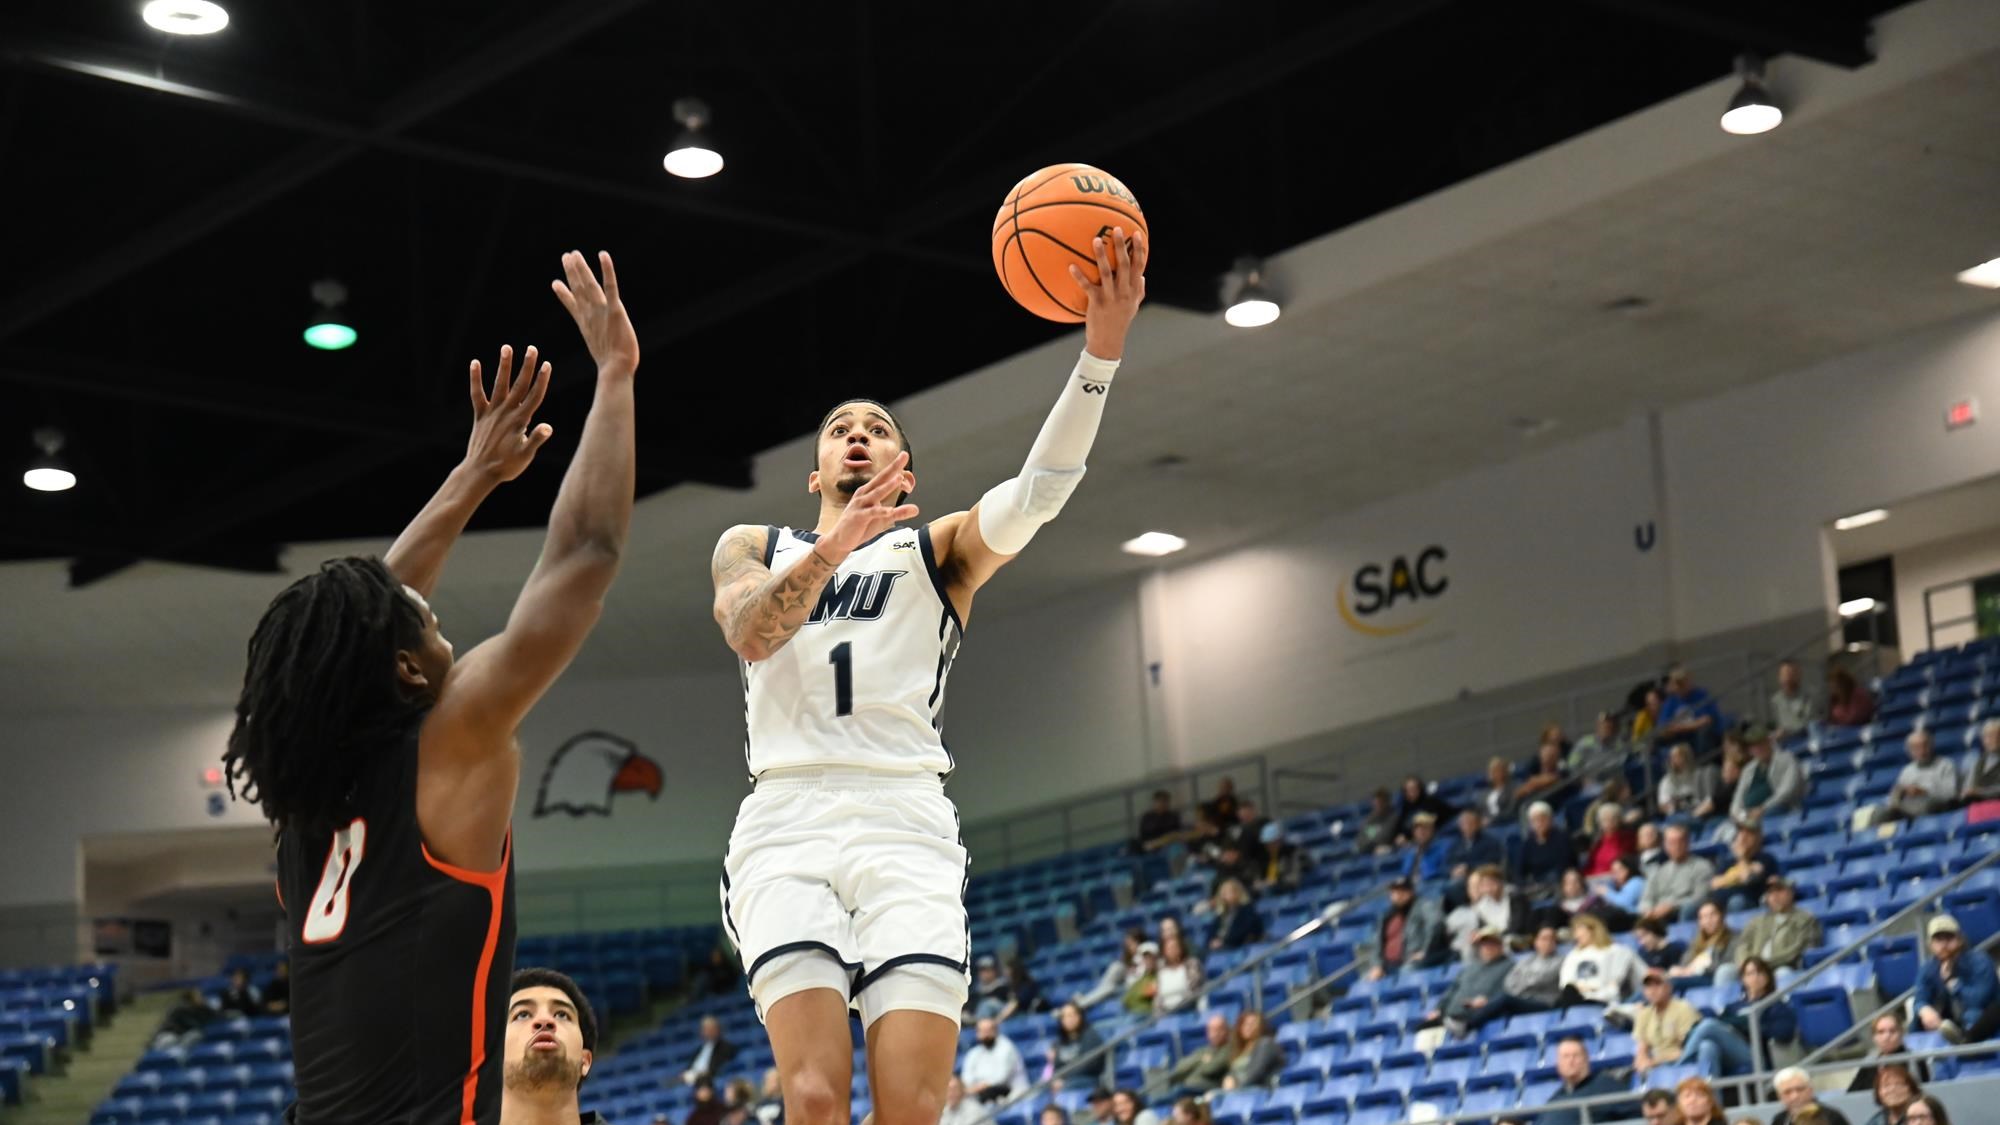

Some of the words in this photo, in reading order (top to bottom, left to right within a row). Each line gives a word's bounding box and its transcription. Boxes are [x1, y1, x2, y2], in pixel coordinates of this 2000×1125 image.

[1635, 521, 1655, 551] U
[804, 570, 908, 625] MU
[1354, 546, 1448, 615] SAC
[829, 641, 853, 717] 1
[302, 817, 367, 943] 0
